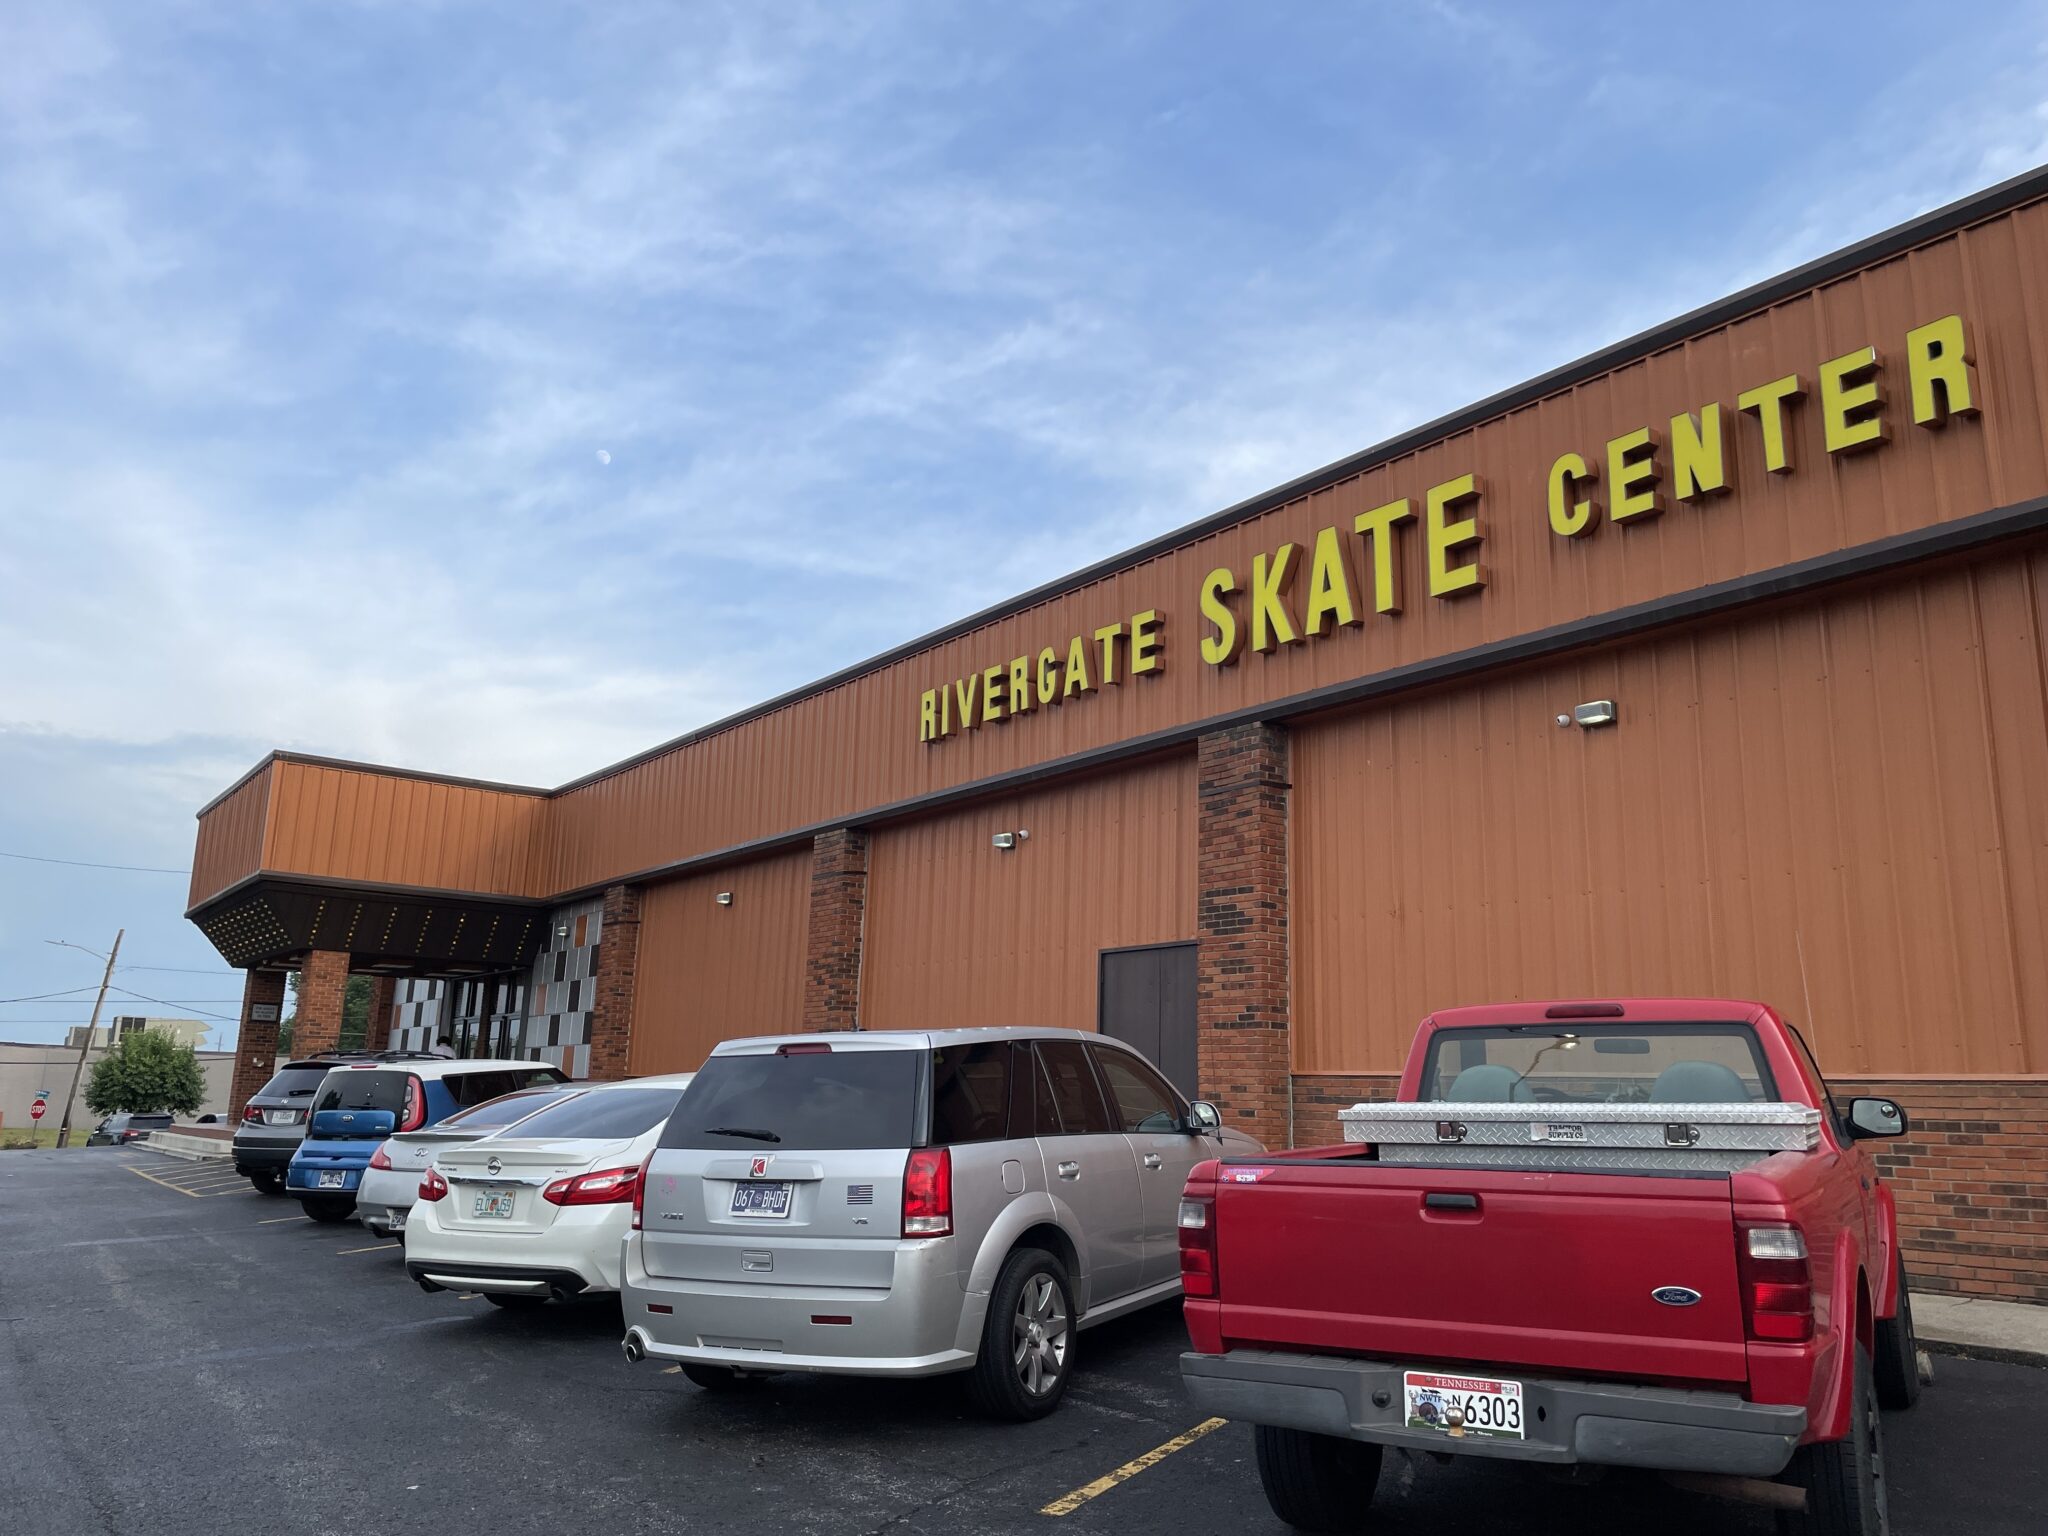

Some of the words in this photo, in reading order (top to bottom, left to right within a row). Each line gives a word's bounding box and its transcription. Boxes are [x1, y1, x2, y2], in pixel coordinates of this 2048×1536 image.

[920, 608, 1160, 743] RIVERGATE
[1200, 472, 1482, 668] SKATE
[1547, 314, 1976, 538] CENTER
[32, 1105, 46, 1114] STOP
[1548, 1131, 1574, 1139] SUPPLY
[734, 1190, 755, 1207] 067
[1663, 1290, 1688, 1301] Ford
[1434, 1377, 1491, 1391] TENNESSEE
[1464, 1394, 1520, 1429] 6303
